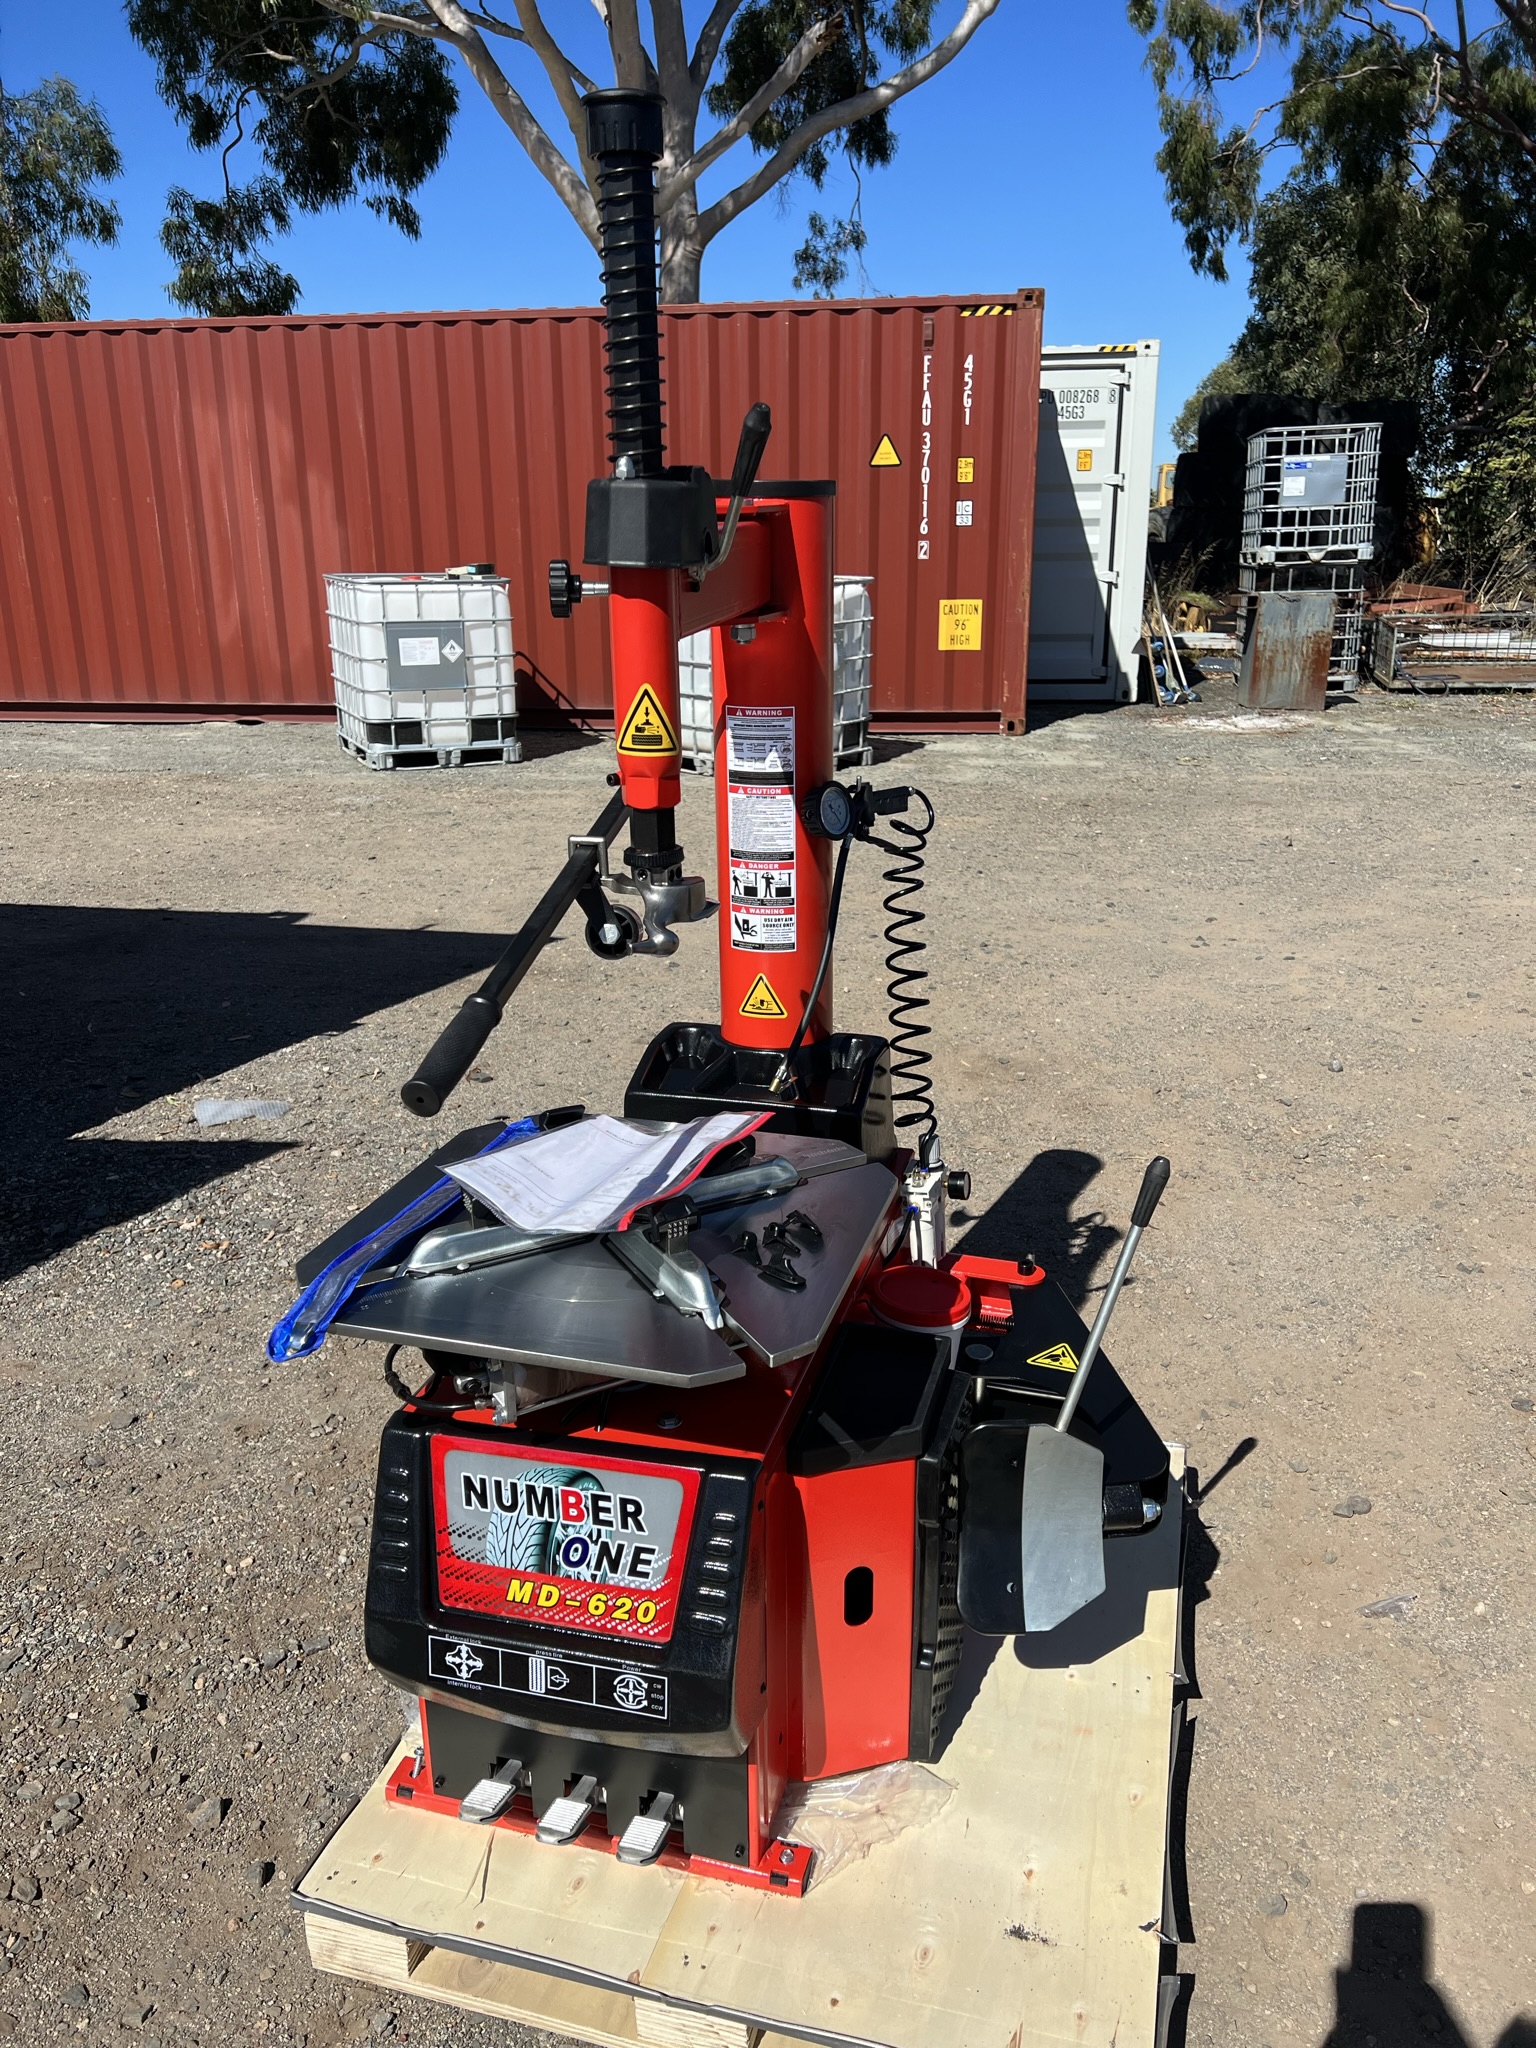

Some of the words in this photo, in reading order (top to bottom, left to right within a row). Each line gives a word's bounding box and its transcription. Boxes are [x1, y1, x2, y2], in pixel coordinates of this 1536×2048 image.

[921, 354, 932, 427] FFAU
[963, 353, 974, 426] 45G1
[1059, 389, 1100, 404] 008268
[1108, 389, 1117, 403] 8
[1057, 405, 1085, 419] 45G3
[920, 431, 931, 535] 370116
[918, 540, 930, 560] 2
[942, 603, 979, 616] CAUTION
[950, 634, 970, 646] HIGH
[746, 787, 782, 795] CAUTION
[460, 1472, 649, 1536] NUMBER
[560, 1535, 659, 1581] ONE
[506, 1578, 658, 1624] MD-620
[622, 1664, 642, 1673] Power
